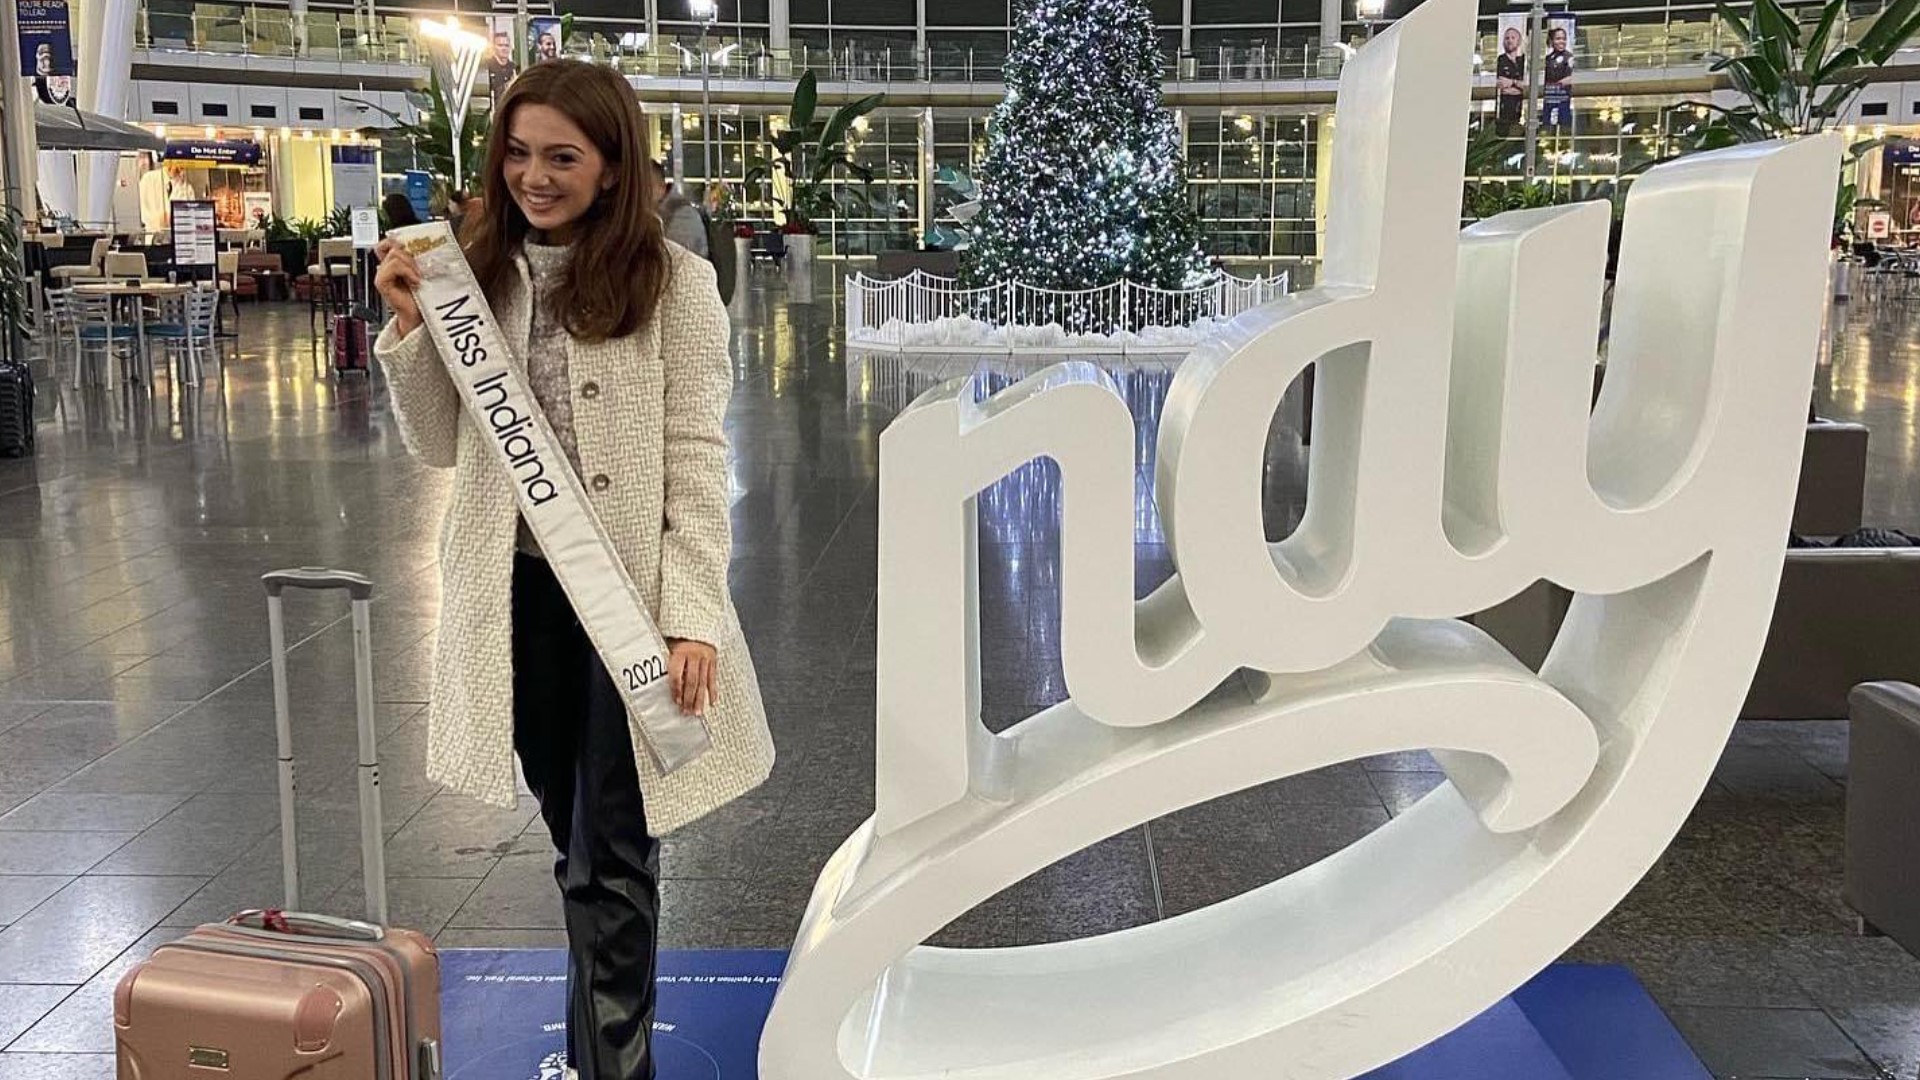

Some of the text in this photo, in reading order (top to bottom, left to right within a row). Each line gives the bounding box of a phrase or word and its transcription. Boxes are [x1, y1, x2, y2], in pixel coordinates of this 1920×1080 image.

[20, 8, 46, 16] TO LEAD
[435, 294, 559, 507] Miss Indiana
[622, 655, 669, 691] 2022
[753, 975, 765, 983] by
